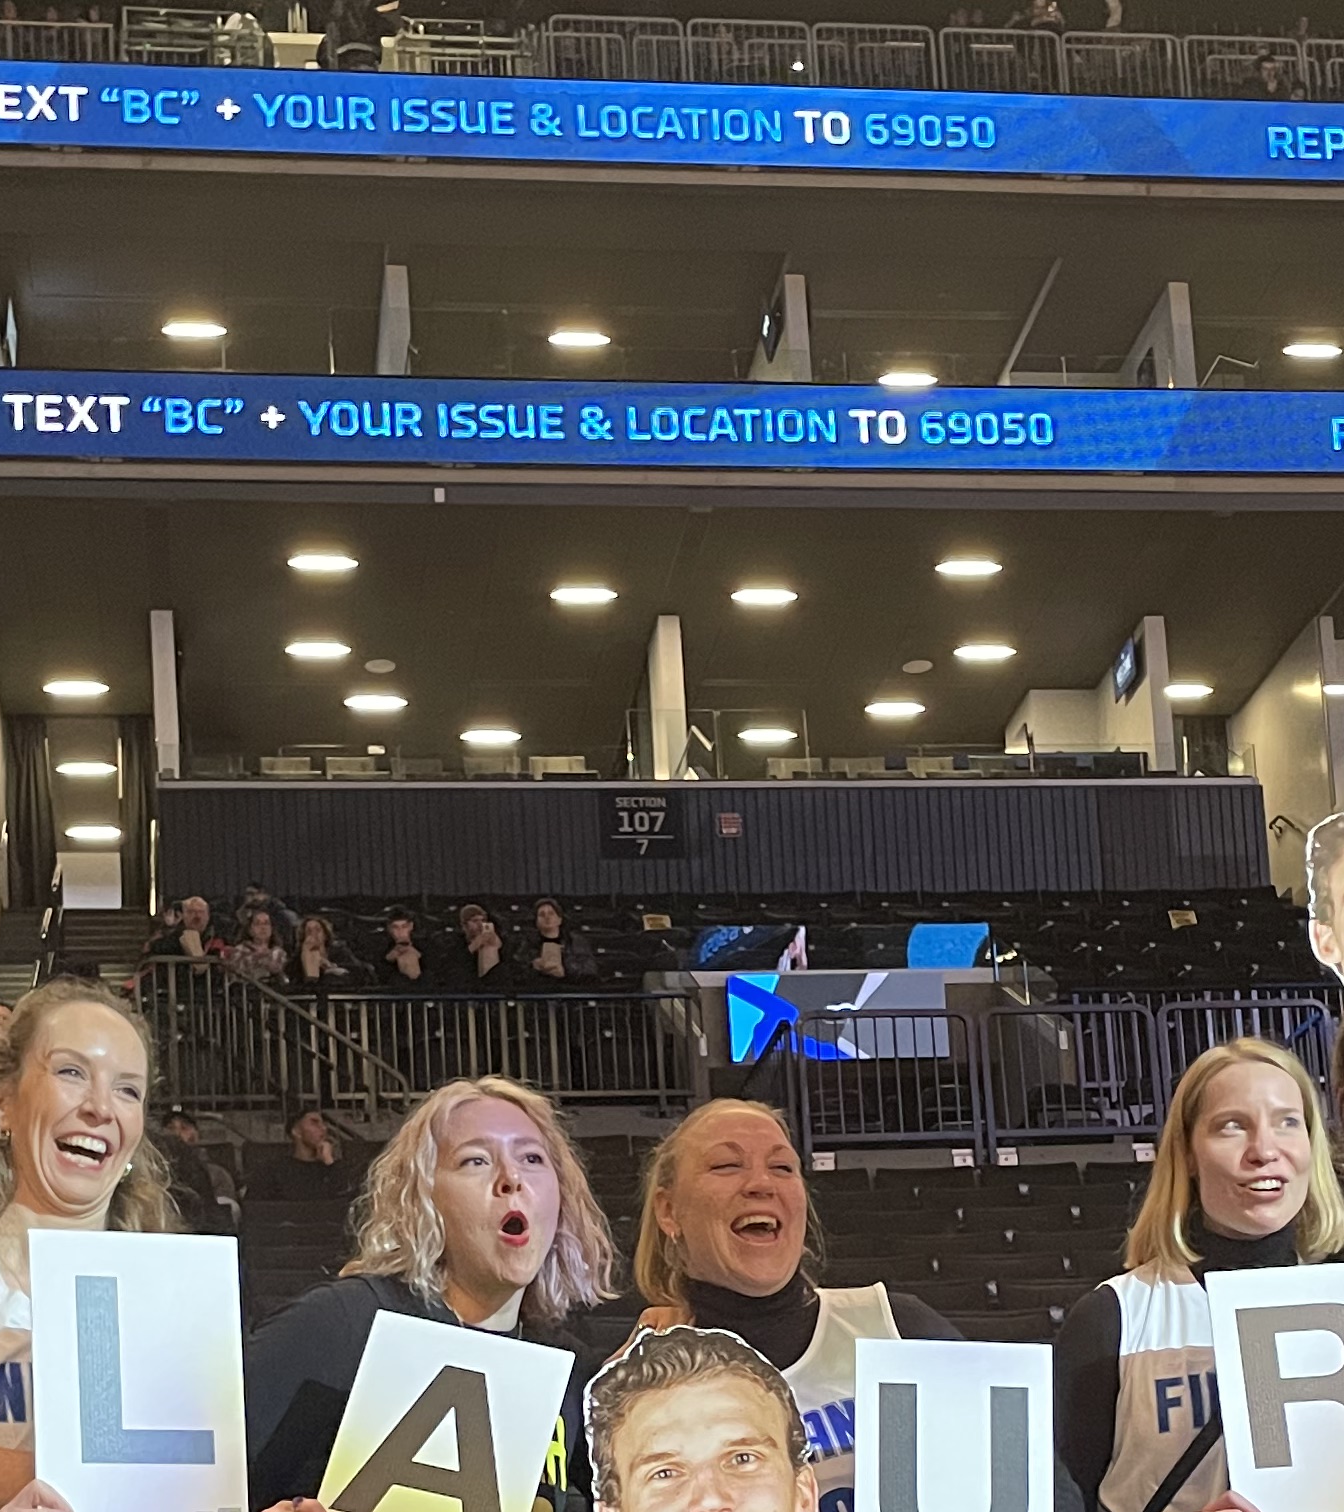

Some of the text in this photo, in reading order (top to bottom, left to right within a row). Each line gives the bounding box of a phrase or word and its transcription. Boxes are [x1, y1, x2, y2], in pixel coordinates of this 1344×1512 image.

[254, 93, 376, 131] YOUR
[390, 98, 515, 135] ISSUE
[529, 103, 563, 137] &
[576, 104, 783, 143] LOCATION
[794, 111, 850, 146] TO
[866, 113, 996, 149] 69050
[2, 394, 130, 433] TEXT
[298, 400, 422, 438] YOUR
[437, 403, 565, 440] ISSUE
[578, 406, 613, 441] &
[627, 407, 838, 443] LOCATION
[849, 409, 907, 445] TO
[920, 411, 1054, 446] 69050
[615, 796, 667, 808] SECTION
[618, 811, 665, 833] 107
[636, 839, 649, 855] 7
[75, 1275, 215, 1464] L
